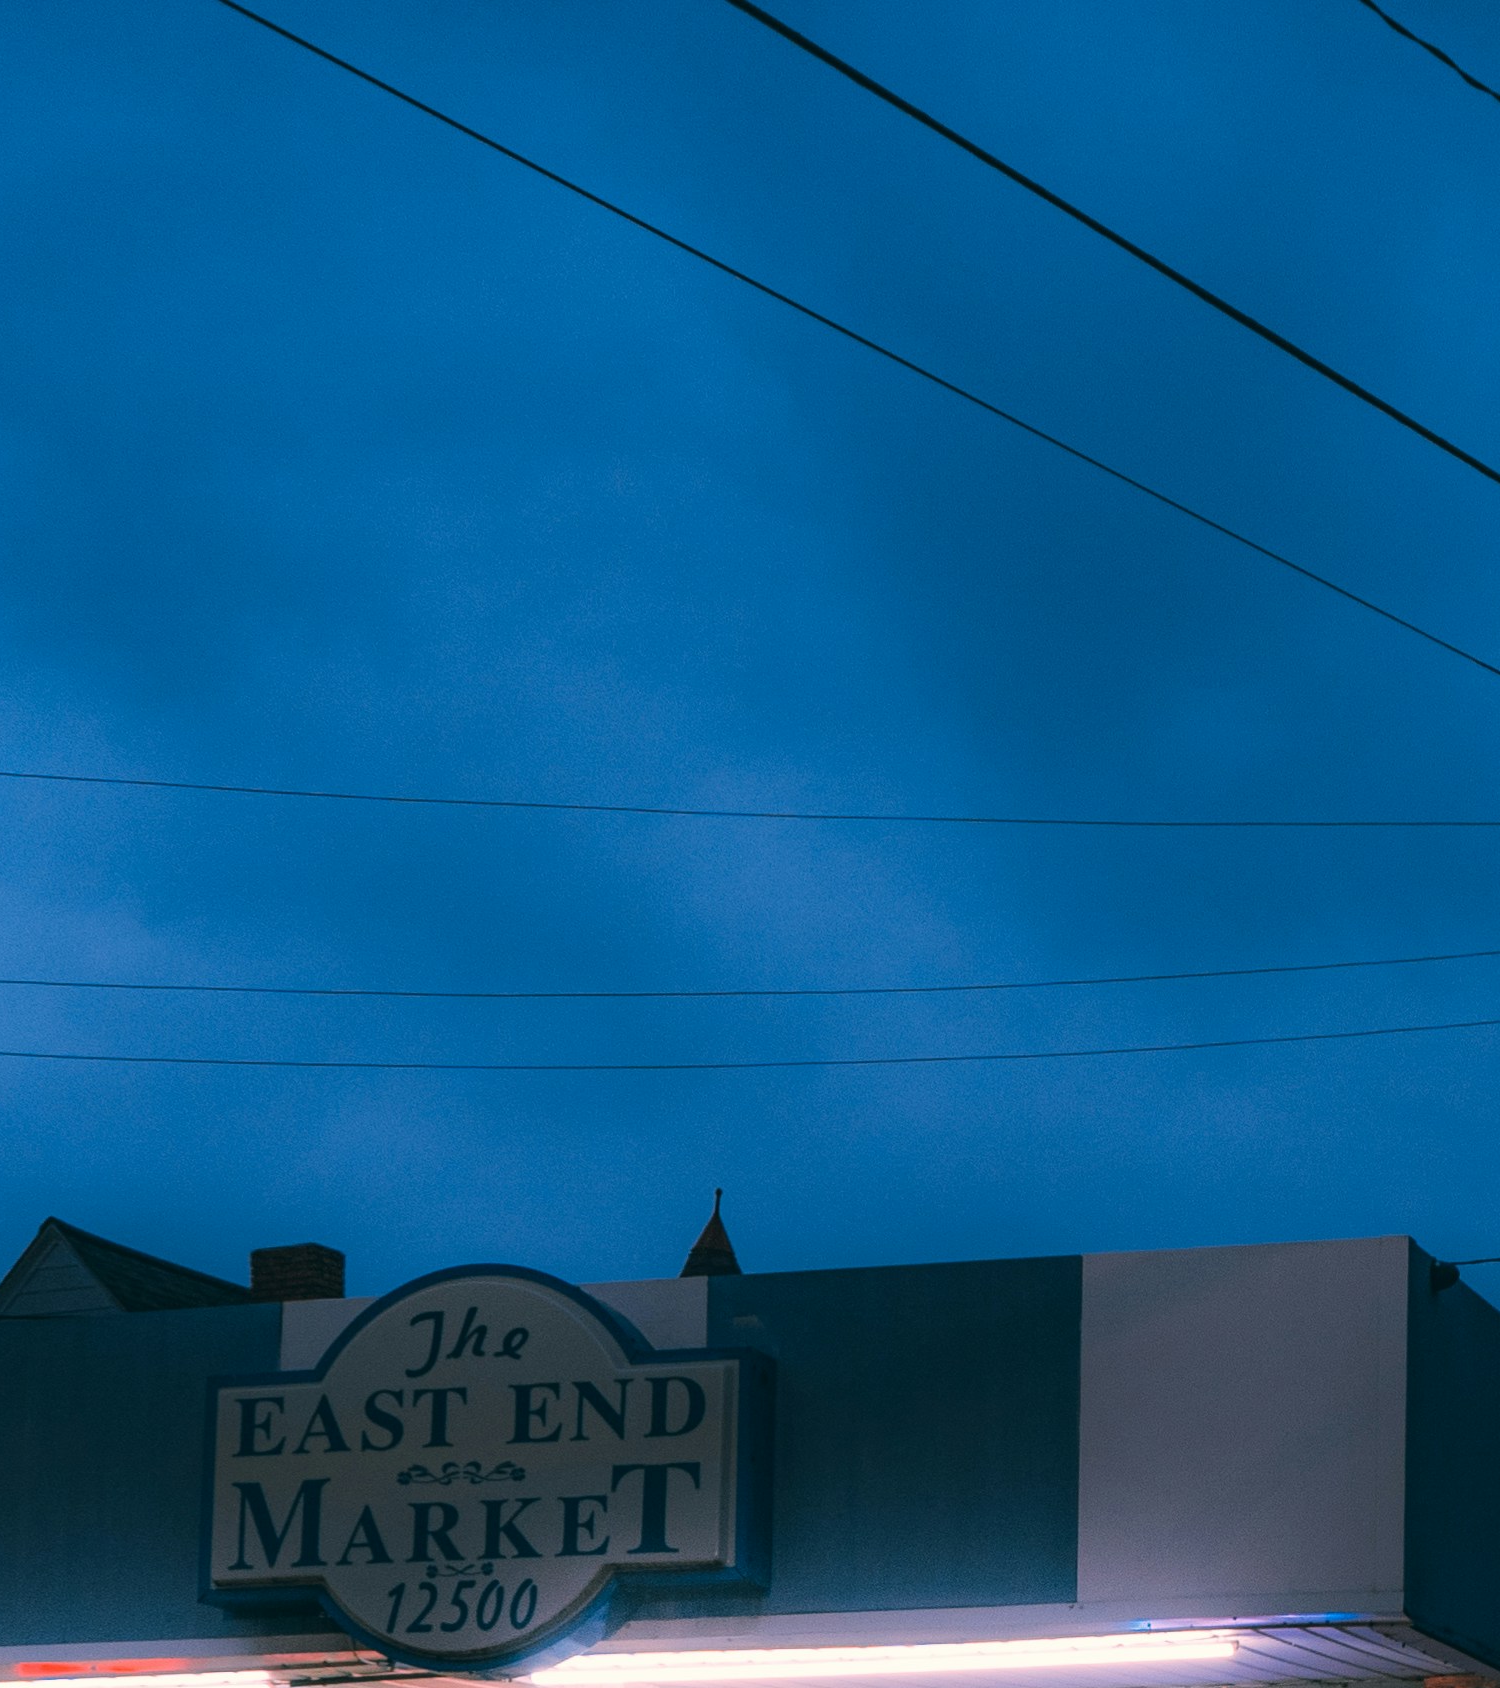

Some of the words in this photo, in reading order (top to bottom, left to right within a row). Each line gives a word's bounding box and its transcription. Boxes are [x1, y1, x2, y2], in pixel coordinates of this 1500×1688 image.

[405, 1306, 529, 1378] The
[231, 1386, 467, 1458] EAST
[505, 1375, 707, 1444] END
[227, 1461, 700, 1570] MARKET
[387, 1578, 538, 1635] 12500
